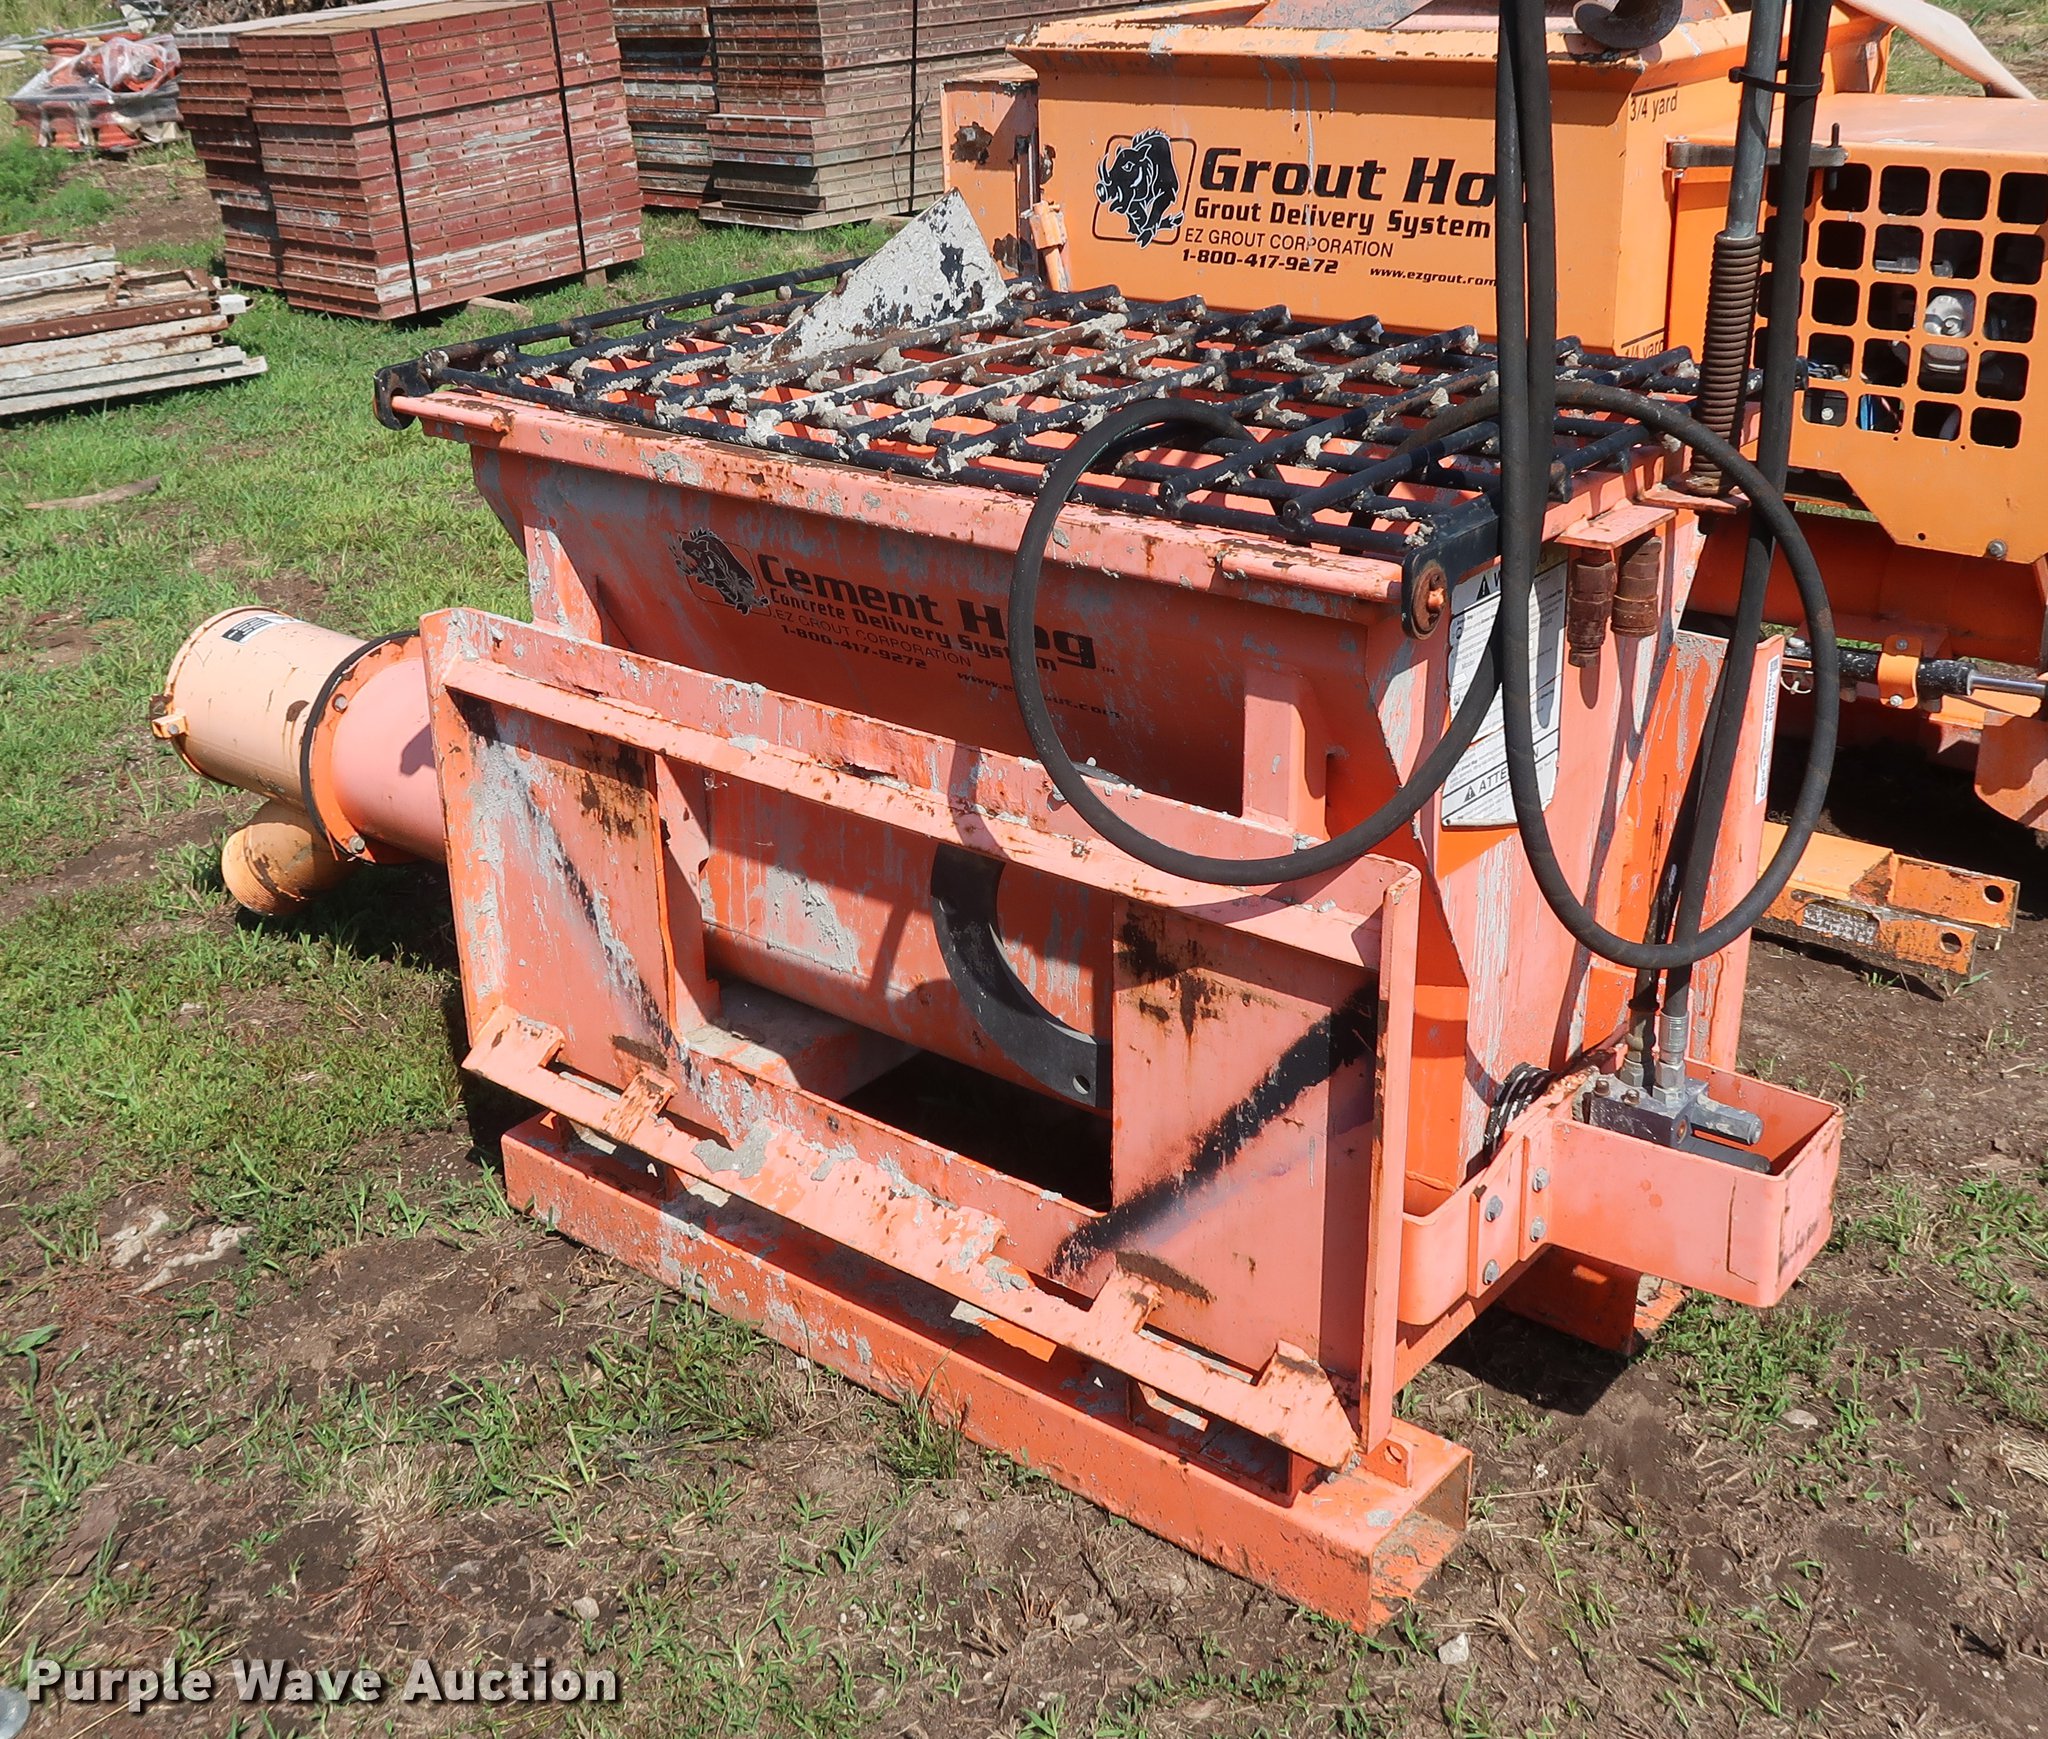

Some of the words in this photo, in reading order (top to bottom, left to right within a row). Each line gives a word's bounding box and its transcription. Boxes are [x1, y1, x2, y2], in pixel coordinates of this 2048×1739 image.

[1630, 97, 1648, 121] 3/4
[1652, 90, 1678, 122] yard
[1200, 148, 1387, 201] Grout
[1402, 157, 1496, 207] Ho
[1194, 197, 1262, 222] Grout
[1269, 202, 1375, 236] Delivery
[1387, 209, 1491, 239] System
[1182, 248, 1340, 275] 1-800-417-9272
[1185, 228, 1202, 243] EZ
[1208, 230, 1266, 248] GROUT
[1269, 233, 1394, 258] CORPORATION
[757, 553, 943, 627] Cement
[769, 587, 846, 620] Concrete
[852, 607, 952, 650] Delivery
[775, 608, 796, 623] EZ
[799, 615, 851, 636] GROUT
[855, 629, 972, 667] CORPORATION
[780, 624, 928, 670] 1-800-417-9272
